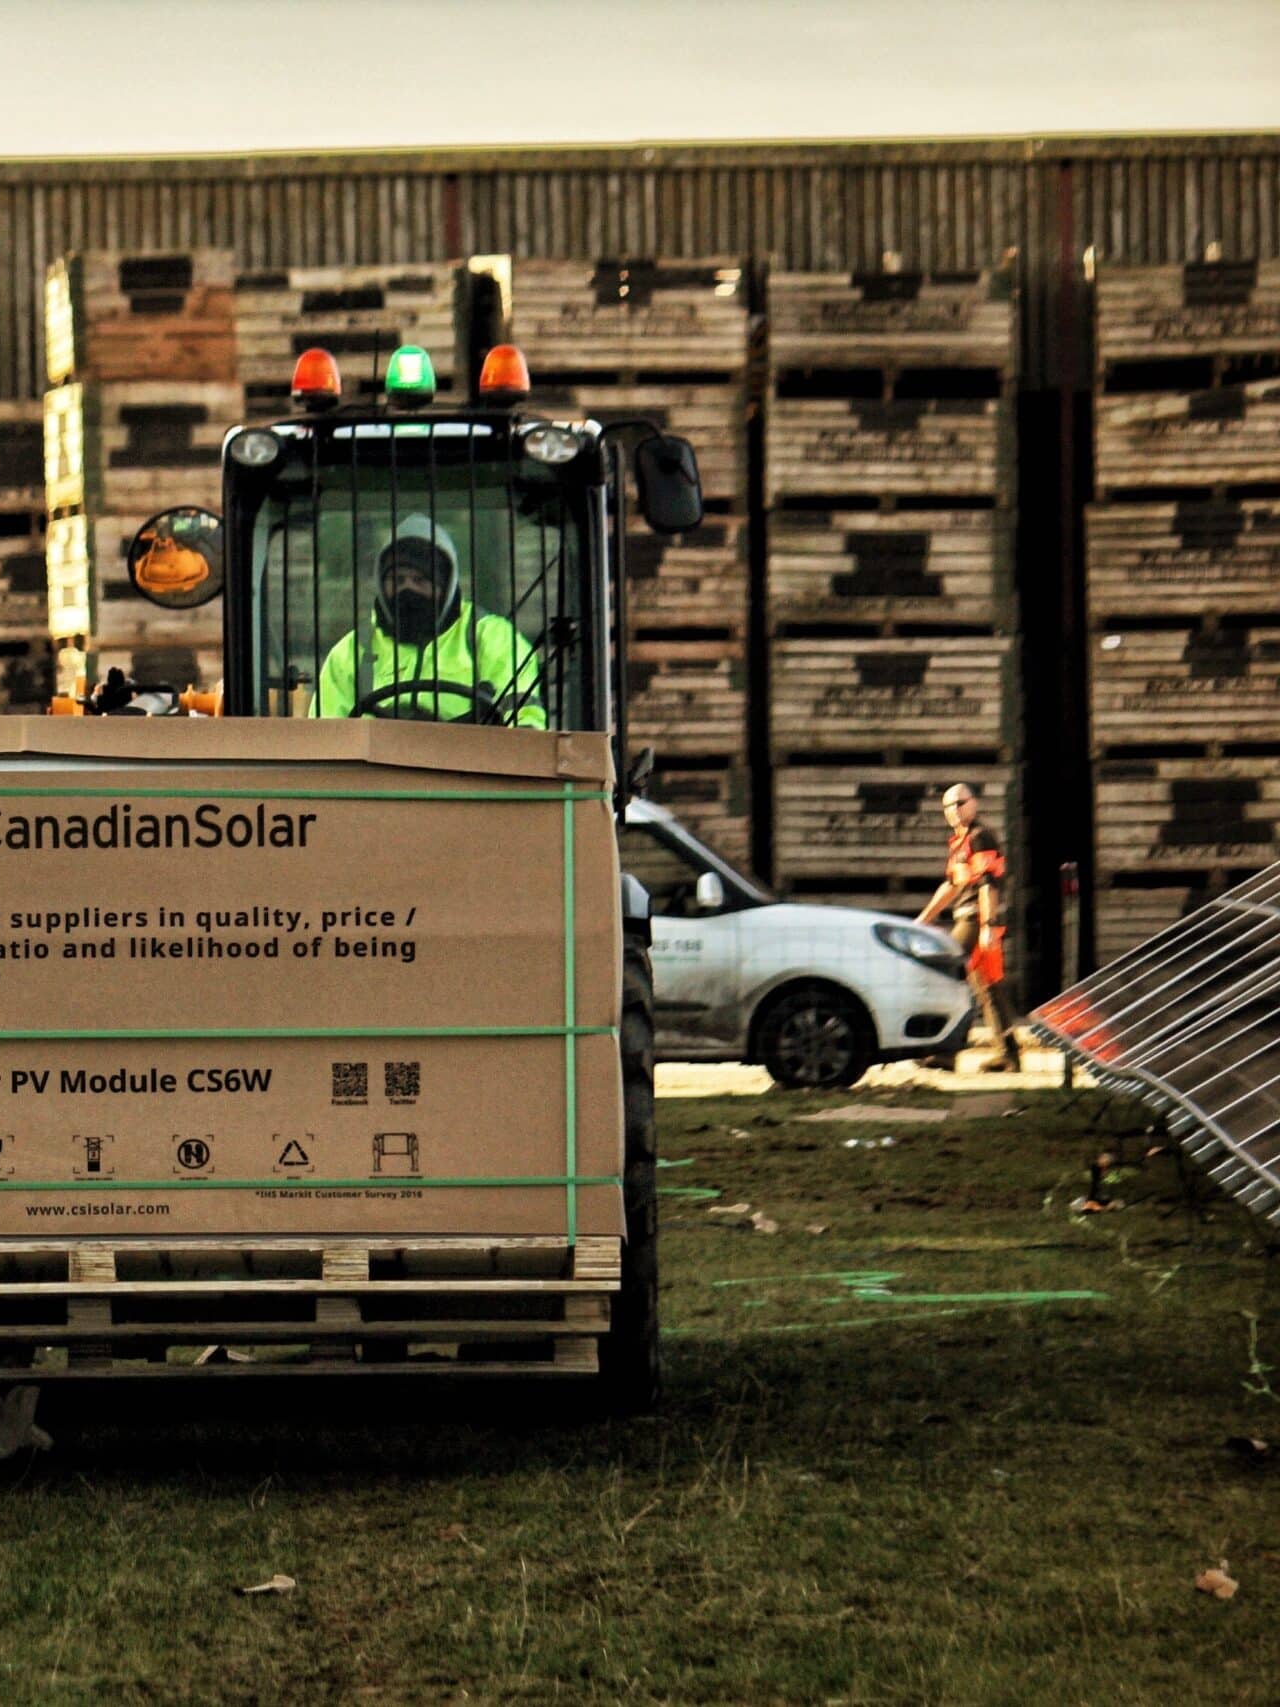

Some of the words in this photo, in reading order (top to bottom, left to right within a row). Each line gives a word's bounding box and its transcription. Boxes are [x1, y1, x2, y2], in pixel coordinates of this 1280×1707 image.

[10, 907, 148, 933] suppliers
[159, 906, 185, 928] in
[195, 905, 310, 932] quality,
[321, 906, 396, 931] price
[62, 937, 116, 959] and
[129, 936, 279, 959] likelihood
[292, 936, 324, 958] of
[334, 936, 417, 964] being
[11, 1070, 51, 1094] PV
[60, 1067, 177, 1094] Module
[186, 1068, 273, 1094] CS6W
[315, 1190, 362, 1199] Customer
[365, 1190, 397, 1200] Survey
[25, 1202, 170, 1217] www.csisolar.com
